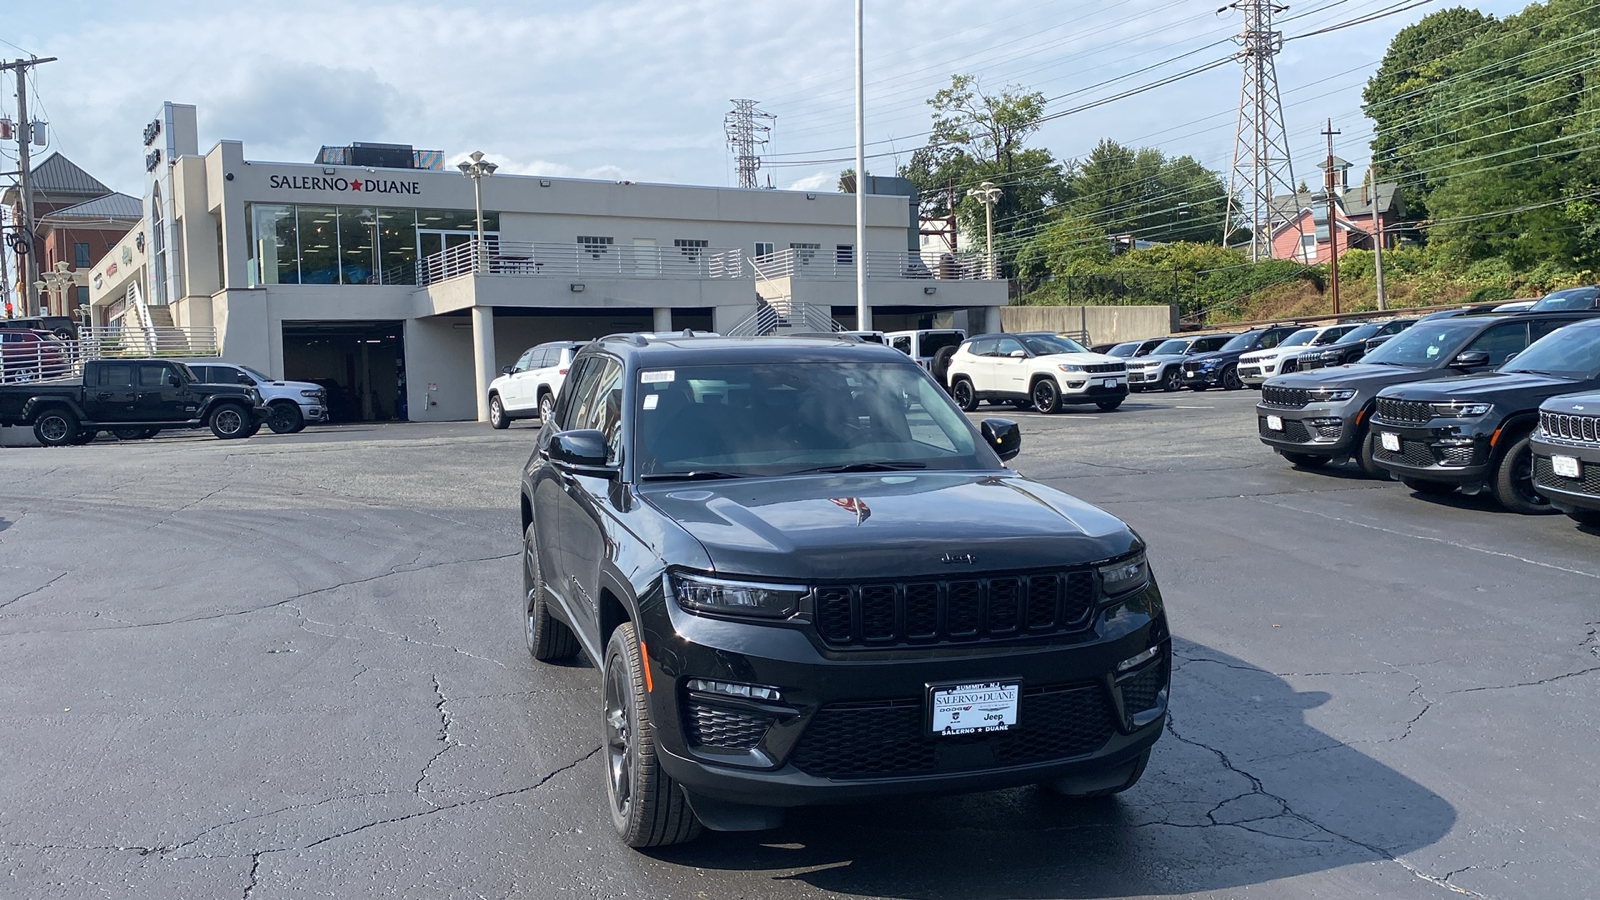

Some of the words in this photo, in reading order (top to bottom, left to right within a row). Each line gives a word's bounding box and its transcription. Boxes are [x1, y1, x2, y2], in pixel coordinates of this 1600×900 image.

[270, 175, 348, 191] SALERNO
[365, 179, 421, 194] DUANE
[941, 552, 976, 565] Jeep
[936, 694, 978, 705] SALERNO
[983, 691, 1015, 701] DUANE
[941, 728, 975, 736] SALERNO
